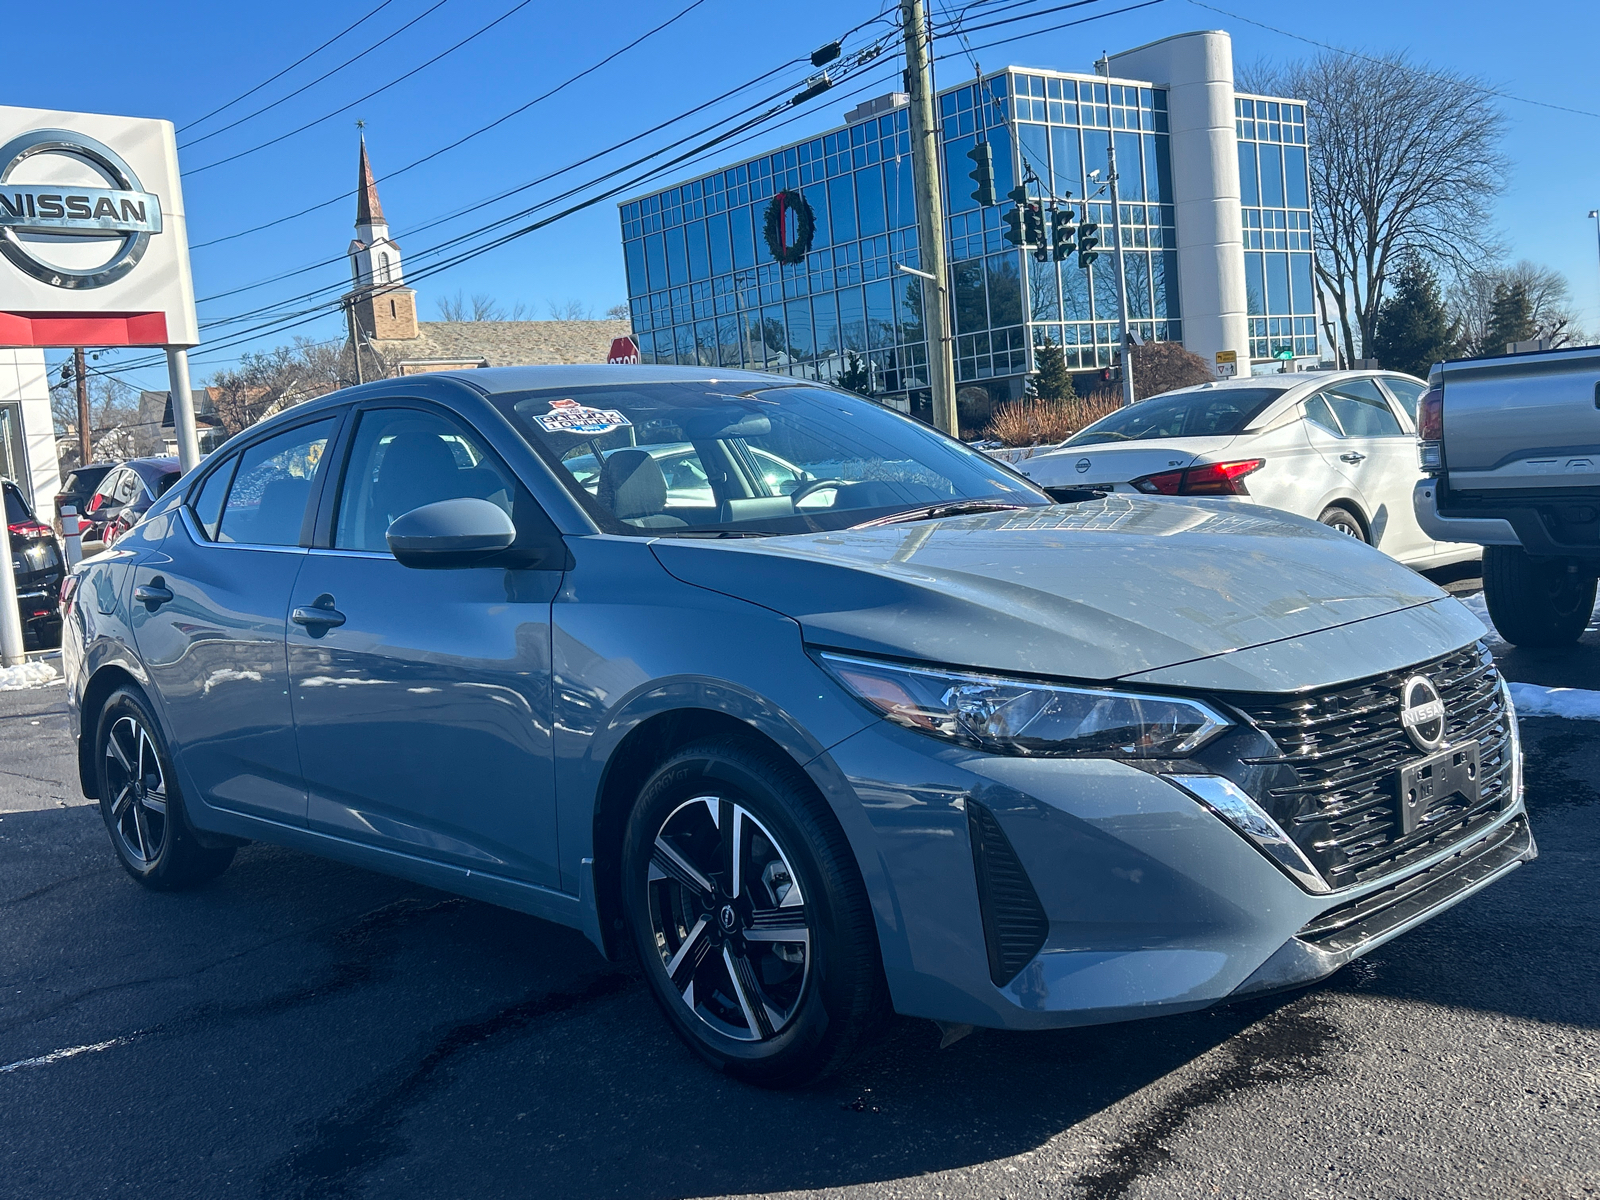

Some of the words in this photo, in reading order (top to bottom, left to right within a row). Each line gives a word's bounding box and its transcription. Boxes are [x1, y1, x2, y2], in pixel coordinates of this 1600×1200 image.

[0, 193, 147, 223] NISSAN
[1404, 702, 1445, 724] NISSAN
[676, 768, 690, 781] GT
